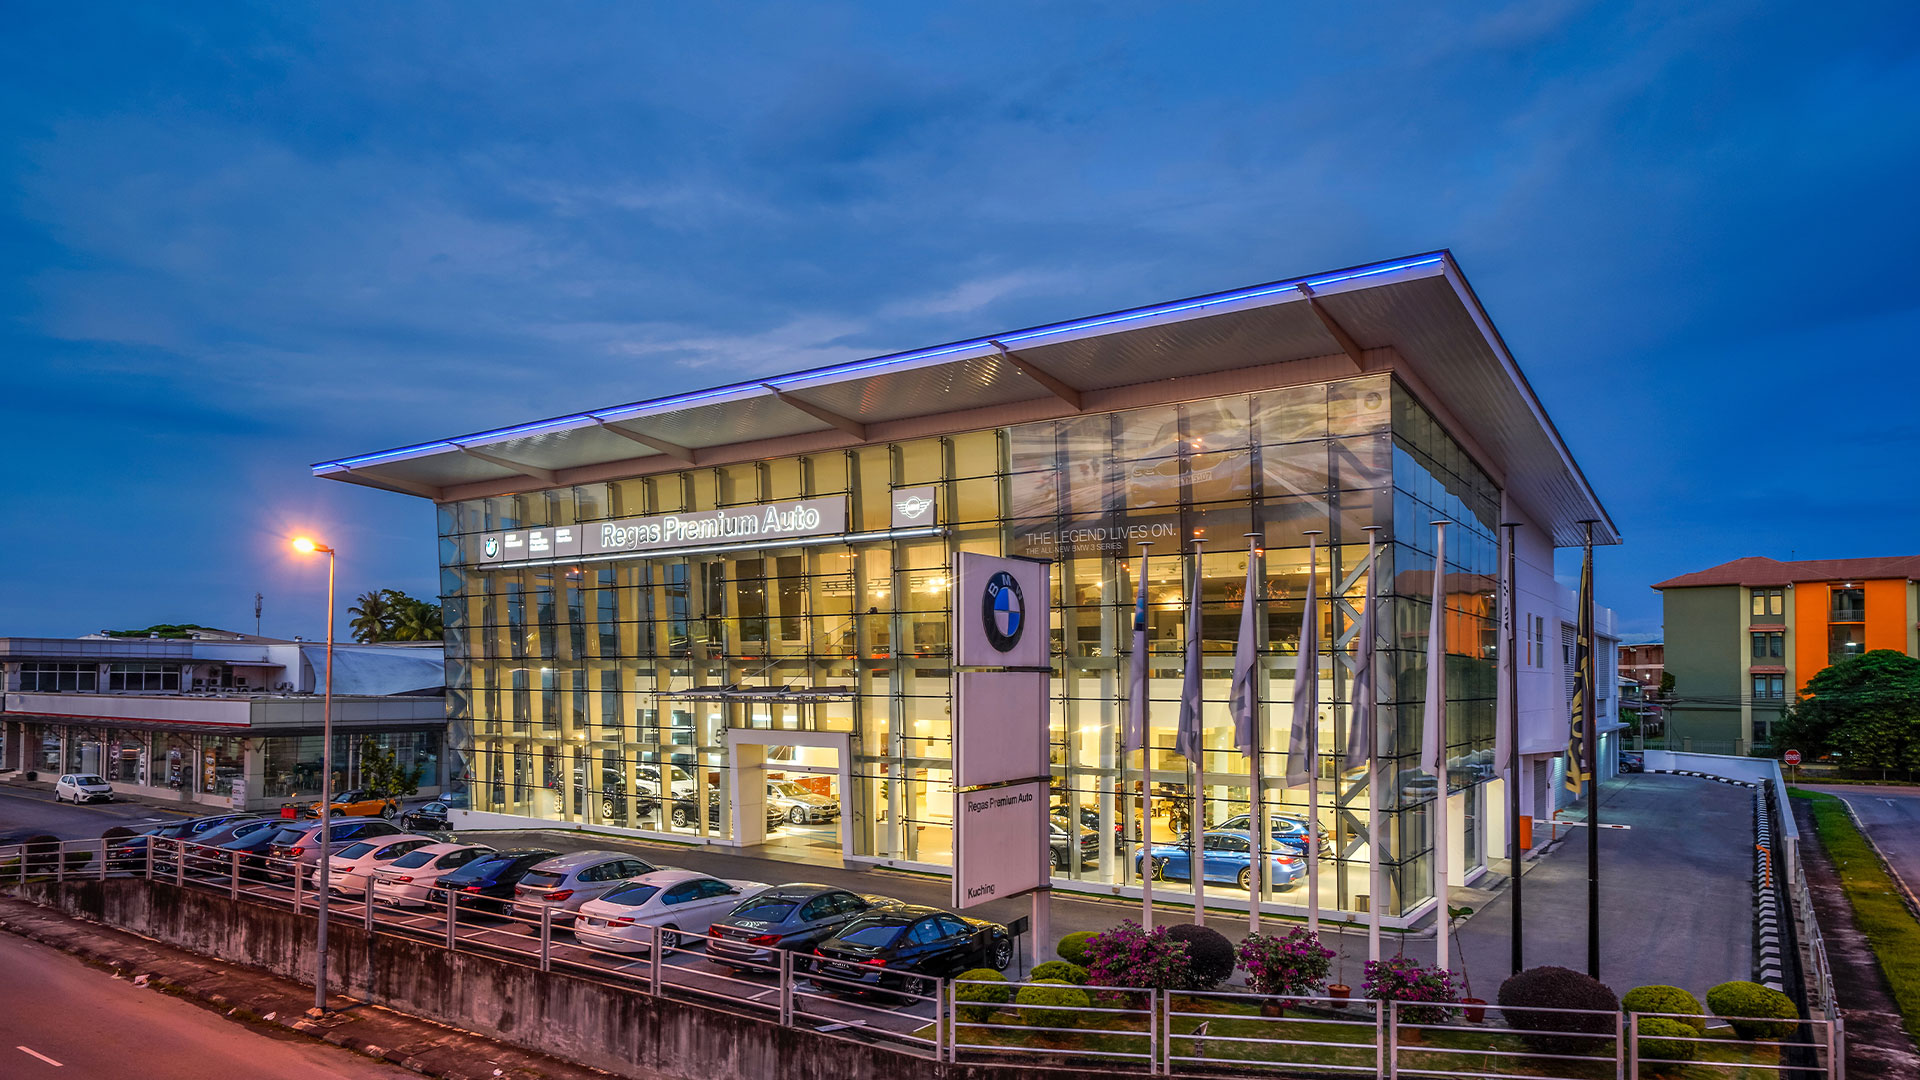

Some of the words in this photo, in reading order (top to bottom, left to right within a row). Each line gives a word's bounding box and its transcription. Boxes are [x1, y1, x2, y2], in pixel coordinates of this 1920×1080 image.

[601, 523, 660, 549] Regas
[664, 512, 758, 541] Premium
[762, 505, 820, 532] Auto
[1025, 532, 1051, 545] THE
[1054, 528, 1107, 544] LEGEND
[1110, 524, 1148, 540] LIVES
[1151, 523, 1177, 538] ON.
[1054, 545, 1070, 553] NEW
[1072, 544, 1090, 552] BMW
[1096, 542, 1124, 551] SERIES.
[988, 574, 1023, 601] BMW
[967, 800, 989, 813] Regas
[989, 795, 1018, 809] Premium
[1018, 793, 1033, 804] Auto
[967, 883, 995, 899] Kuching
